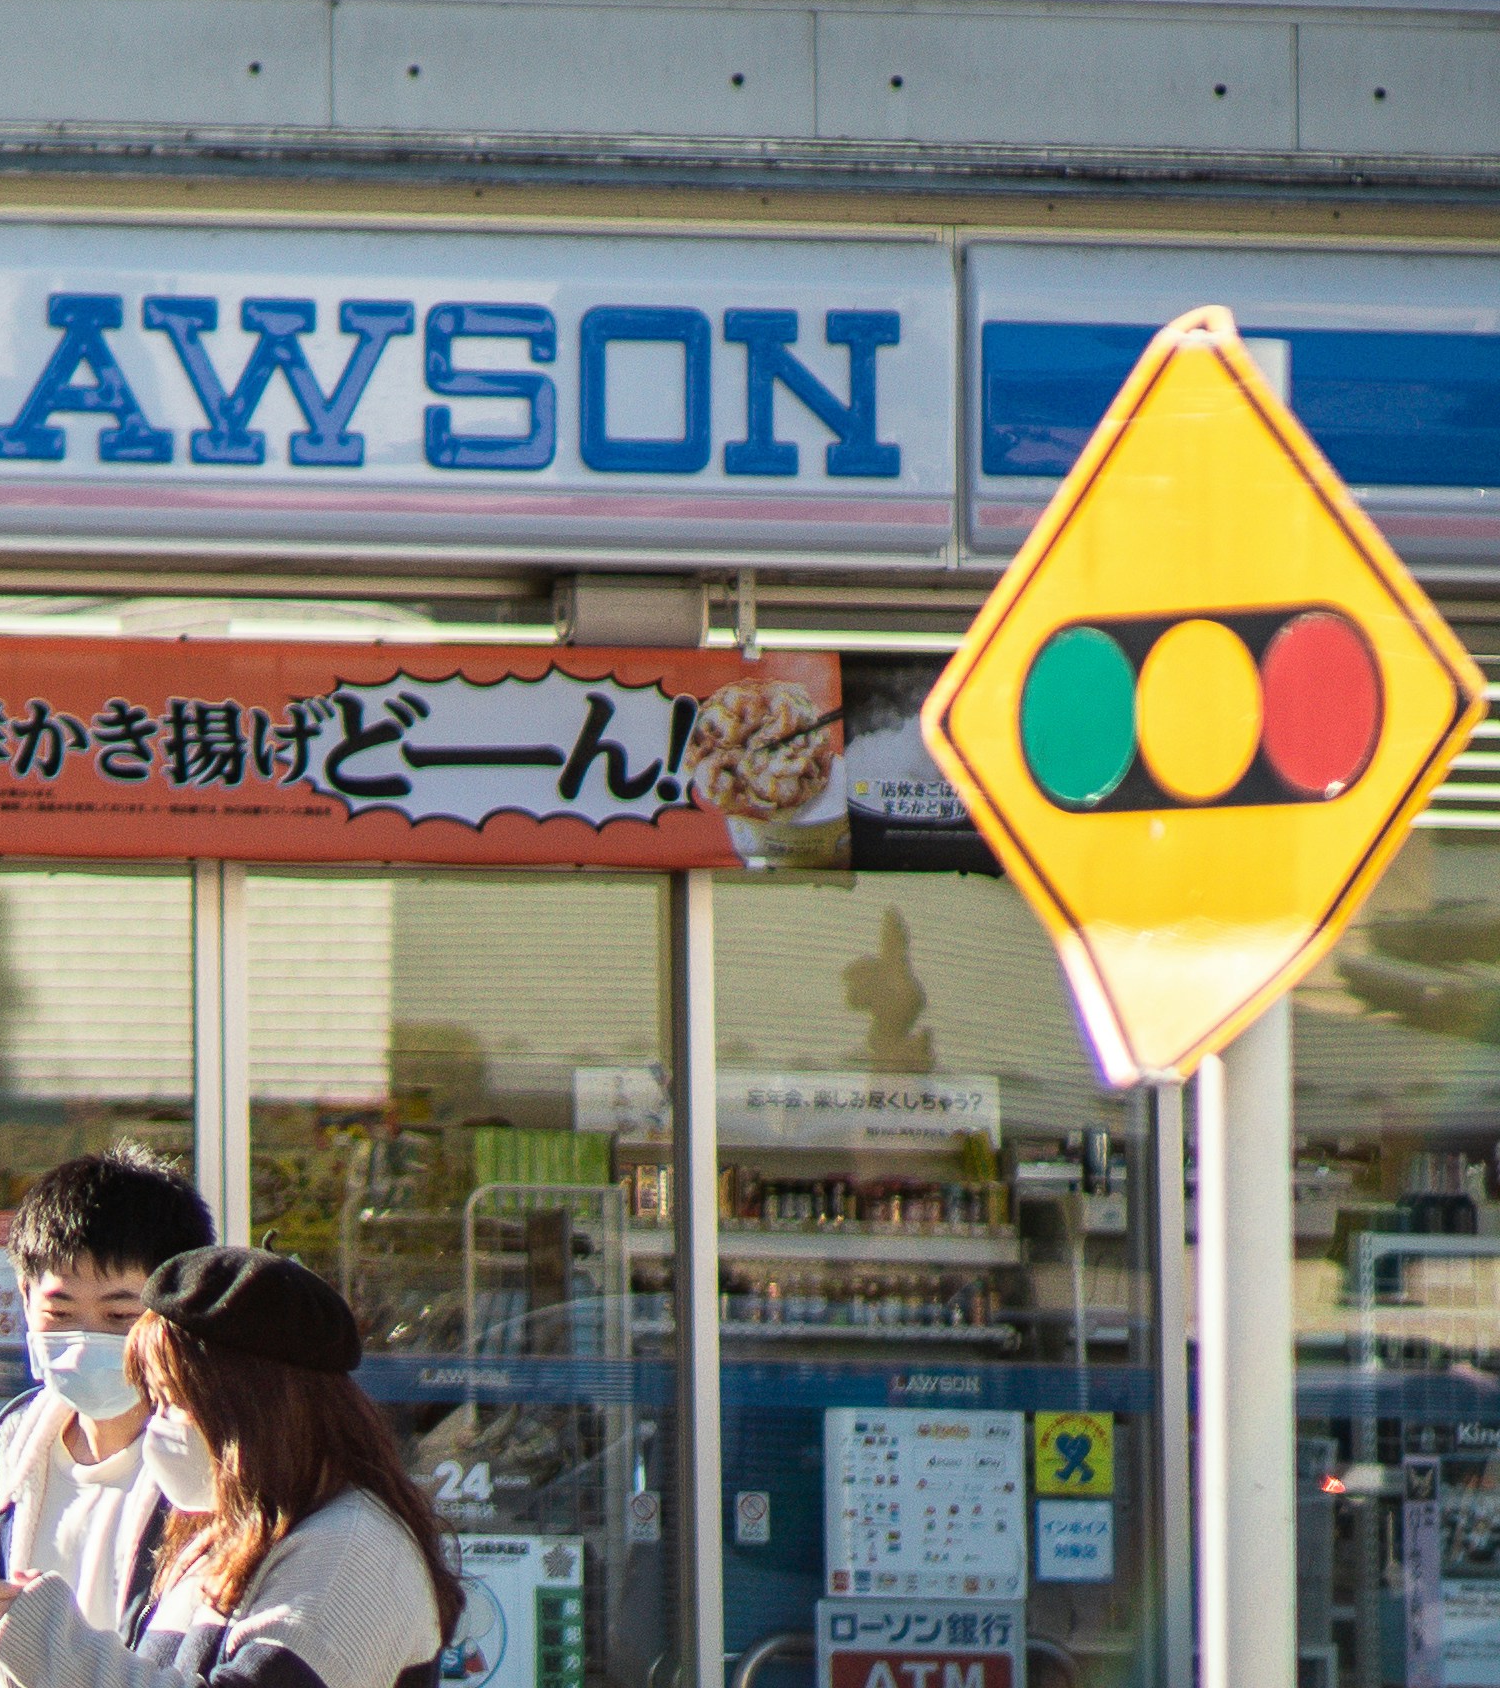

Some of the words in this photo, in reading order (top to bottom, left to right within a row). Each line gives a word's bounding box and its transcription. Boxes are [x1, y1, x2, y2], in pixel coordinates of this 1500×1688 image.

[890, 1374, 981, 1392] LAWSON
[433, 1459, 495, 1501] 24
[830, 1612, 1013, 1646] ローソン銀行
[864, 1661, 986, 1688] ATM
